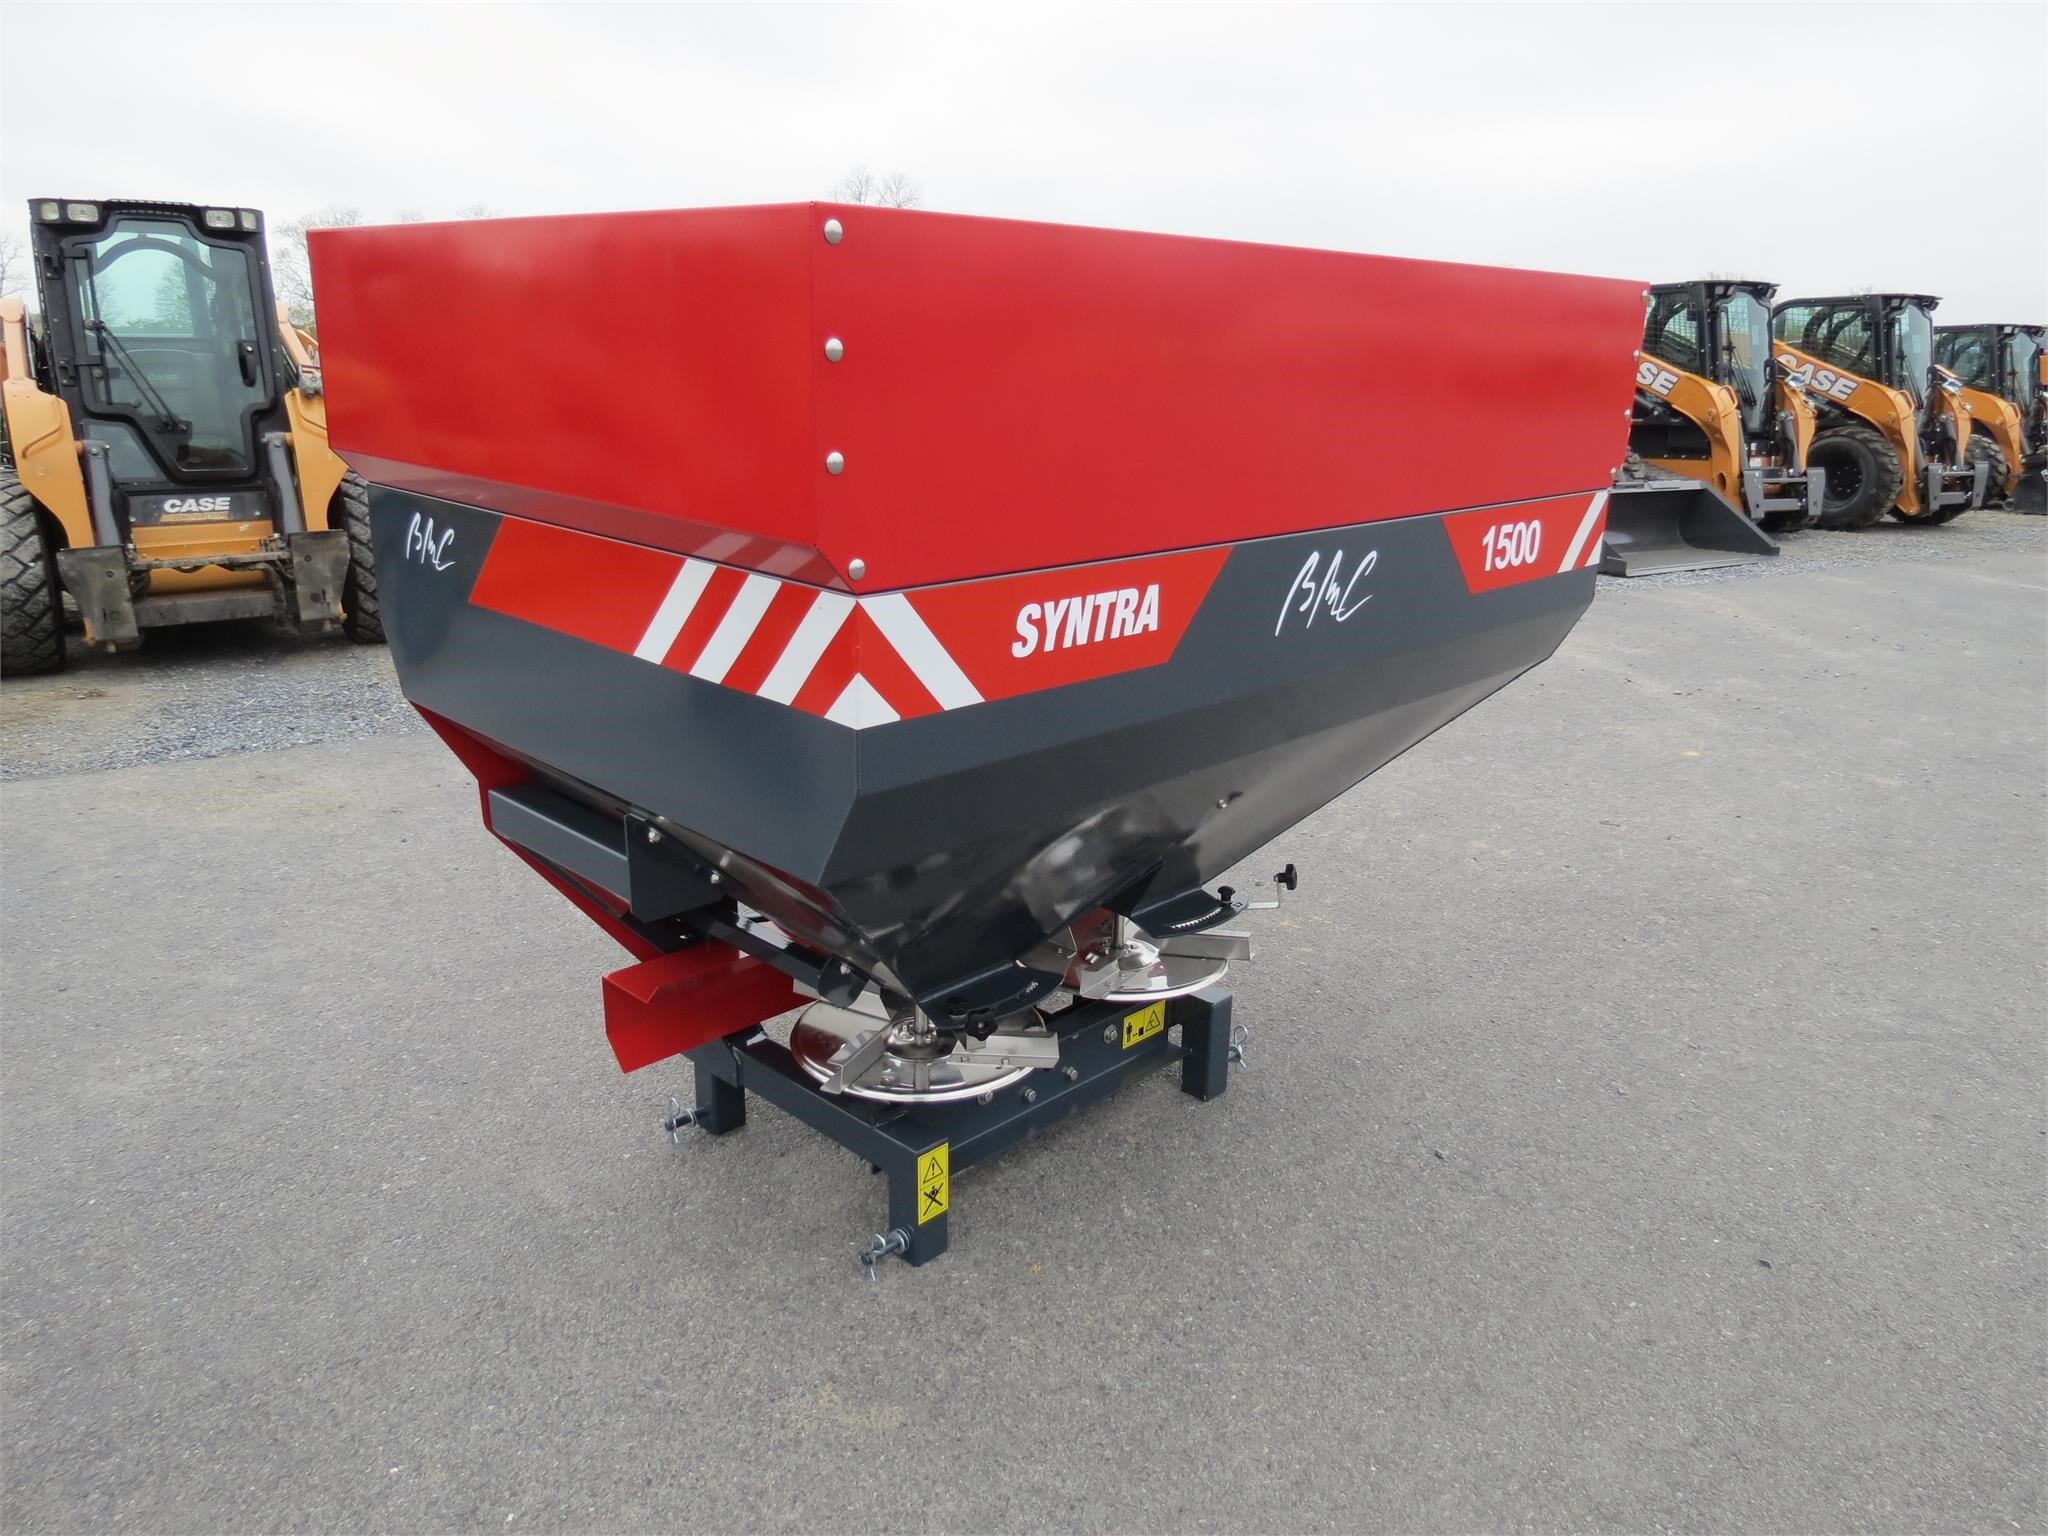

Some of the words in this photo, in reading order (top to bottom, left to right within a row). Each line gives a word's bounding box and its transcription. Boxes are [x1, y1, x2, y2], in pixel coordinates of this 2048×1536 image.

[1636, 361, 1679, 396] SE
[163, 496, 232, 514] CASE
[1482, 519, 1542, 572] 1500
[1011, 583, 1160, 659] SYNTRA
